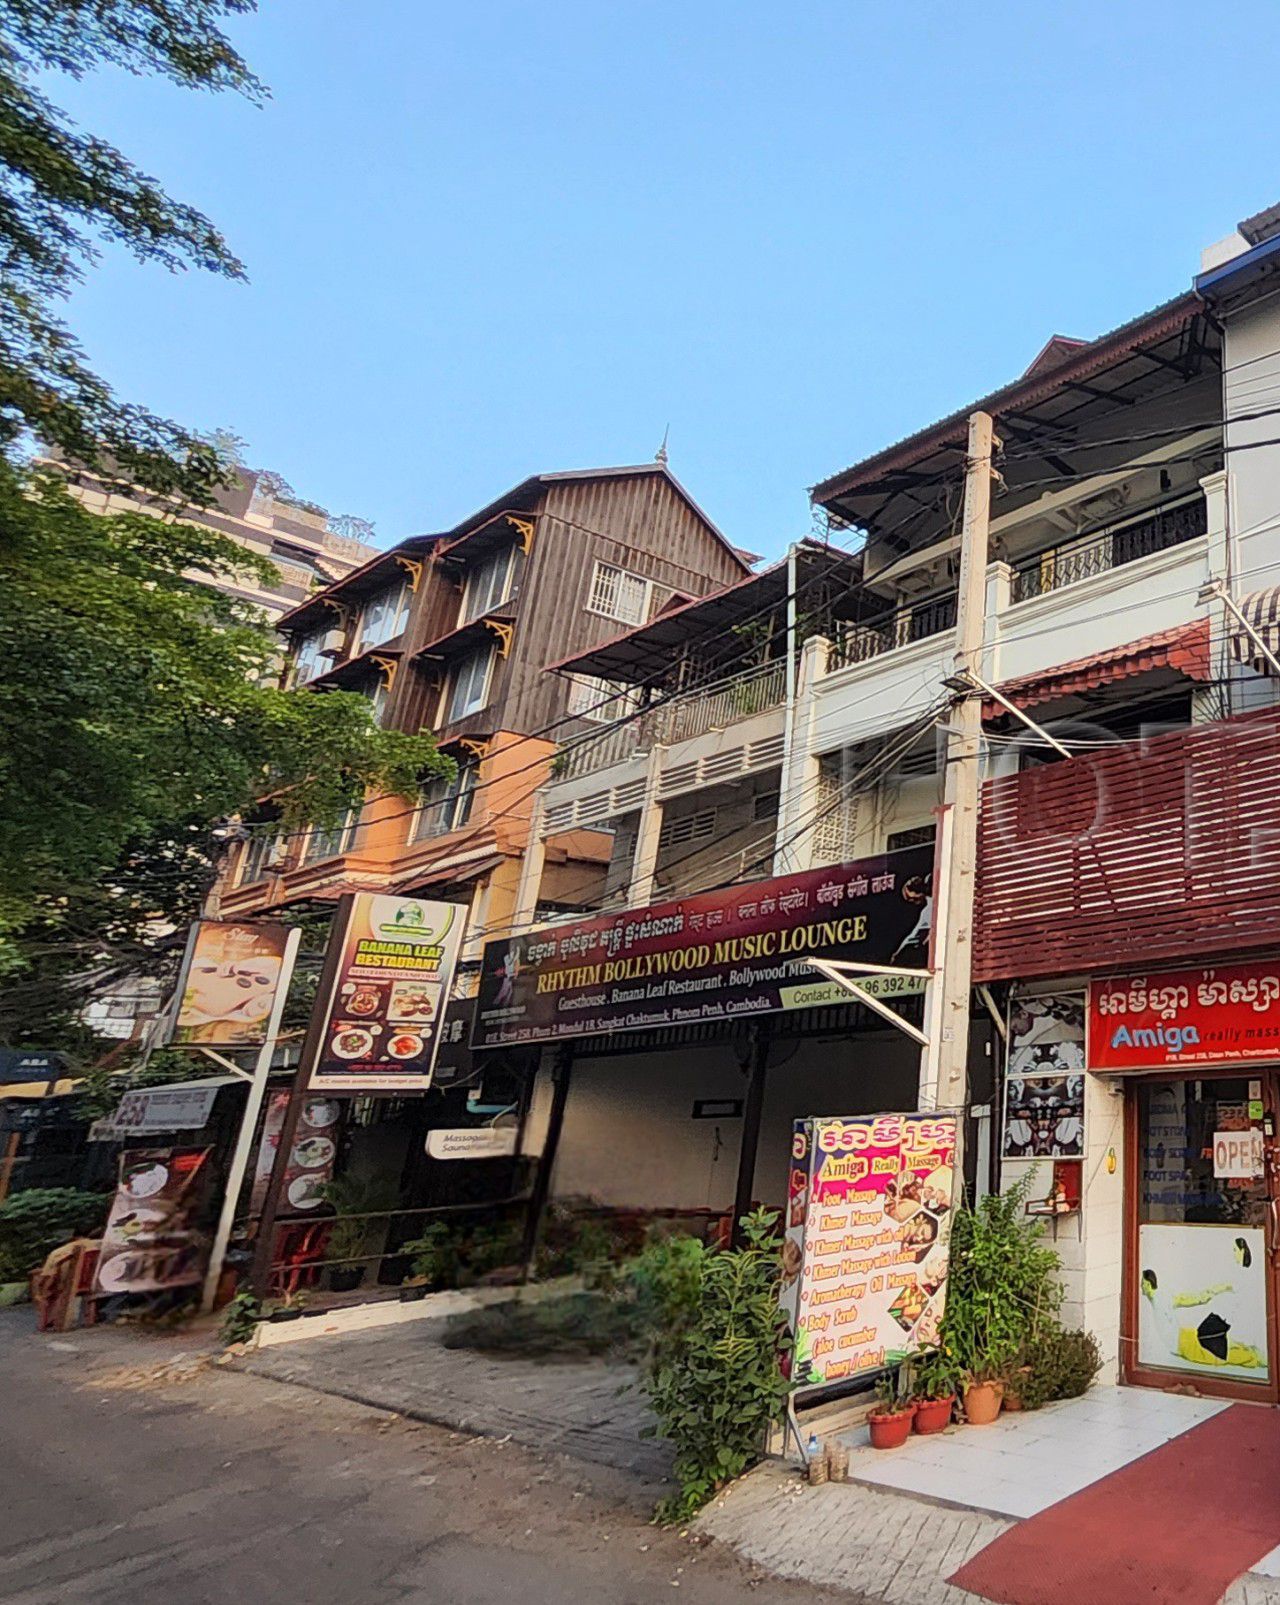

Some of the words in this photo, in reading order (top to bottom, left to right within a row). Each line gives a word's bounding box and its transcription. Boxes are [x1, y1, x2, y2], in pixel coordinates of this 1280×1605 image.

[358, 940, 413, 956] BANANA
[413, 944, 444, 958] LEAF
[535, 963, 602, 994] RHYTHM
[603, 944, 710, 984] BOLLYWOOD
[713, 930, 777, 966] MUSIC
[780, 915, 868, 955] LOUNGE
[355, 953, 441, 971] RESTAURANT
[612, 985, 645, 1004] Banana
[646, 979, 669, 999] Leaf
[668, 974, 722, 995] Restaurant
[729, 960, 786, 987] Bollywood
[793, 984, 832, 1004] Contact
[865, 978, 880, 995] 96
[882, 975, 905, 992] 392
[1110, 1021, 1201, 1052] Amiga
[1203, 1028, 1241, 1043] really
[821, 1156, 866, 1179] Amiga
[874, 1157, 899, 1173] Really
[907, 1155, 940, 1170] Massage
[1215, 1140, 1263, 1170] OPEN
[846, 1188, 877, 1204] Massage
[851, 1210, 882, 1226] Massage
[843, 1235, 875, 1251] Massage
[841, 1259, 873, 1275] Massage
[809, 1283, 867, 1307] Aromatherapy
[870, 1275, 883, 1293] Oil
[887, 1272, 917, 1290] Massage
[807, 1312, 831, 1332] Body
[834, 1305, 857, 1326] Scrub
